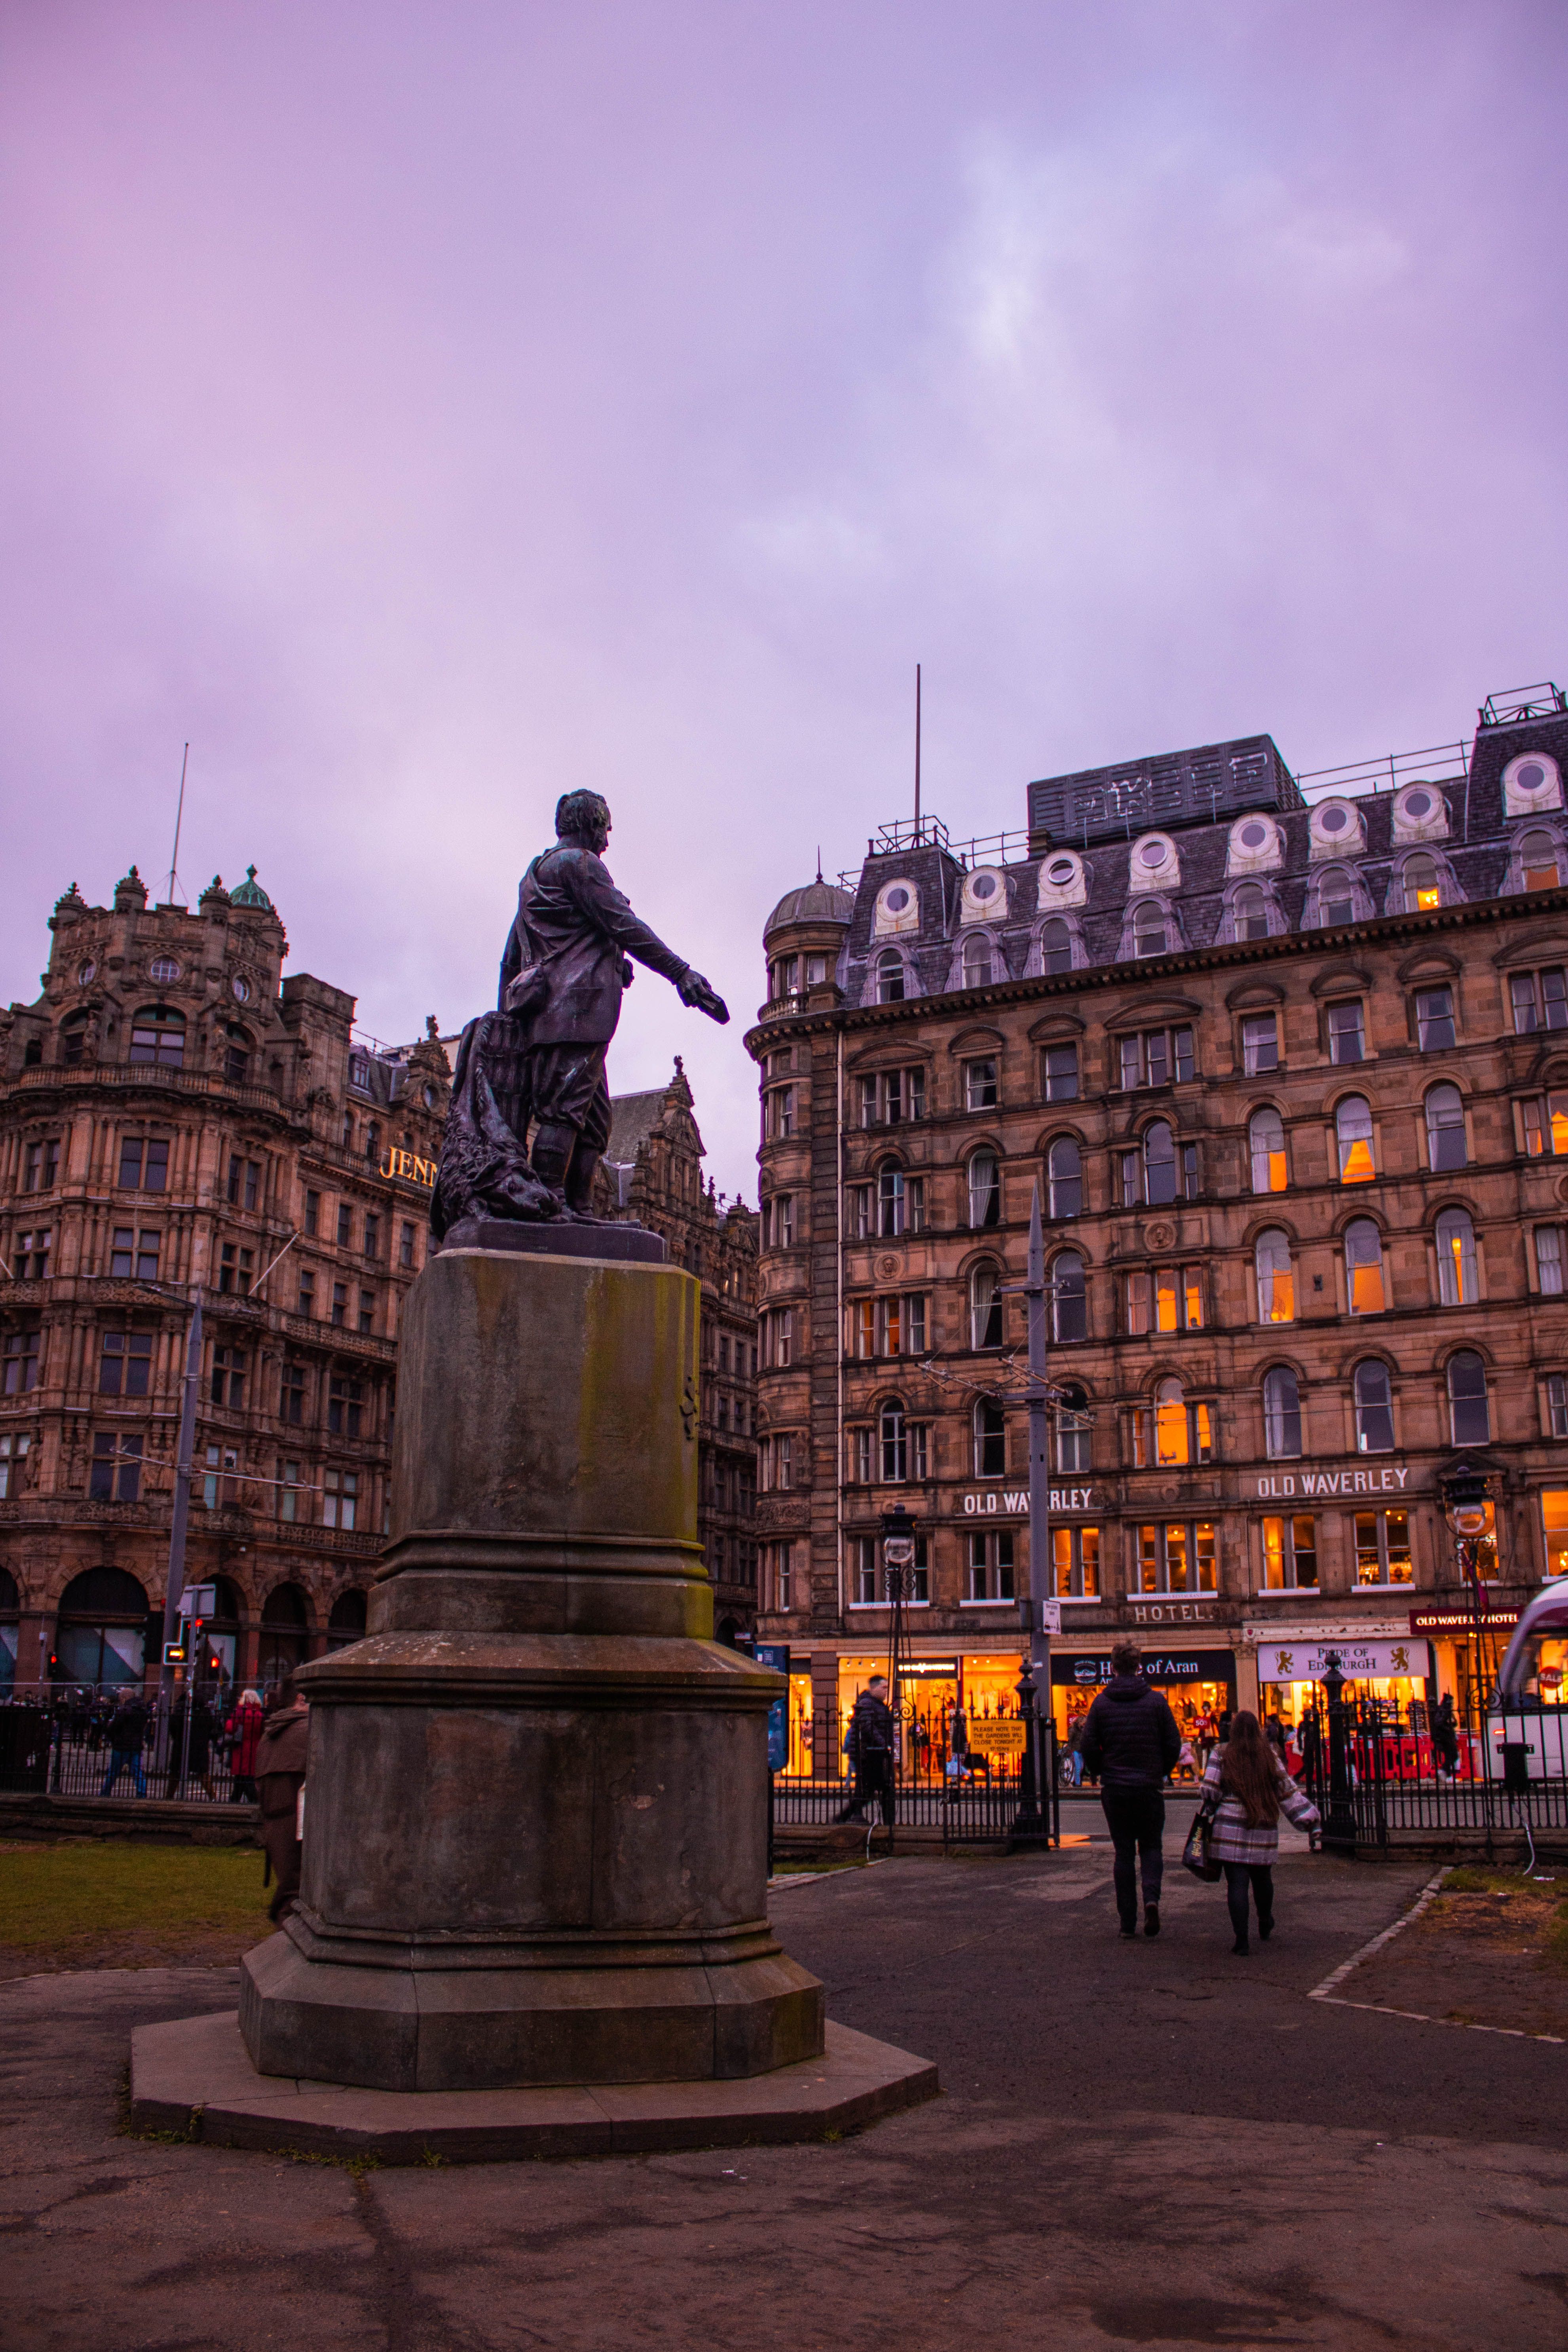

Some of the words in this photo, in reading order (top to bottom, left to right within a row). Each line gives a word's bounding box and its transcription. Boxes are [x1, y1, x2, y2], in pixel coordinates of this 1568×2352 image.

[1258, 1475, 1295, 1498] OLD
[1301, 1468, 1409, 1495] WAVERLEY
[964, 1494, 997, 1514] OLD
[1003, 1488, 1092, 1512] WARLEY
[1416, 1616, 1437, 1626] OLD
[1487, 1613, 1519, 1623] HOTEL
[1353, 1648, 1369, 1657] OF
[1147, 1659, 1163, 1674] of
[1164, 1659, 1198, 1674] Aran
[1540, 1673, 1563, 1683] SALE
